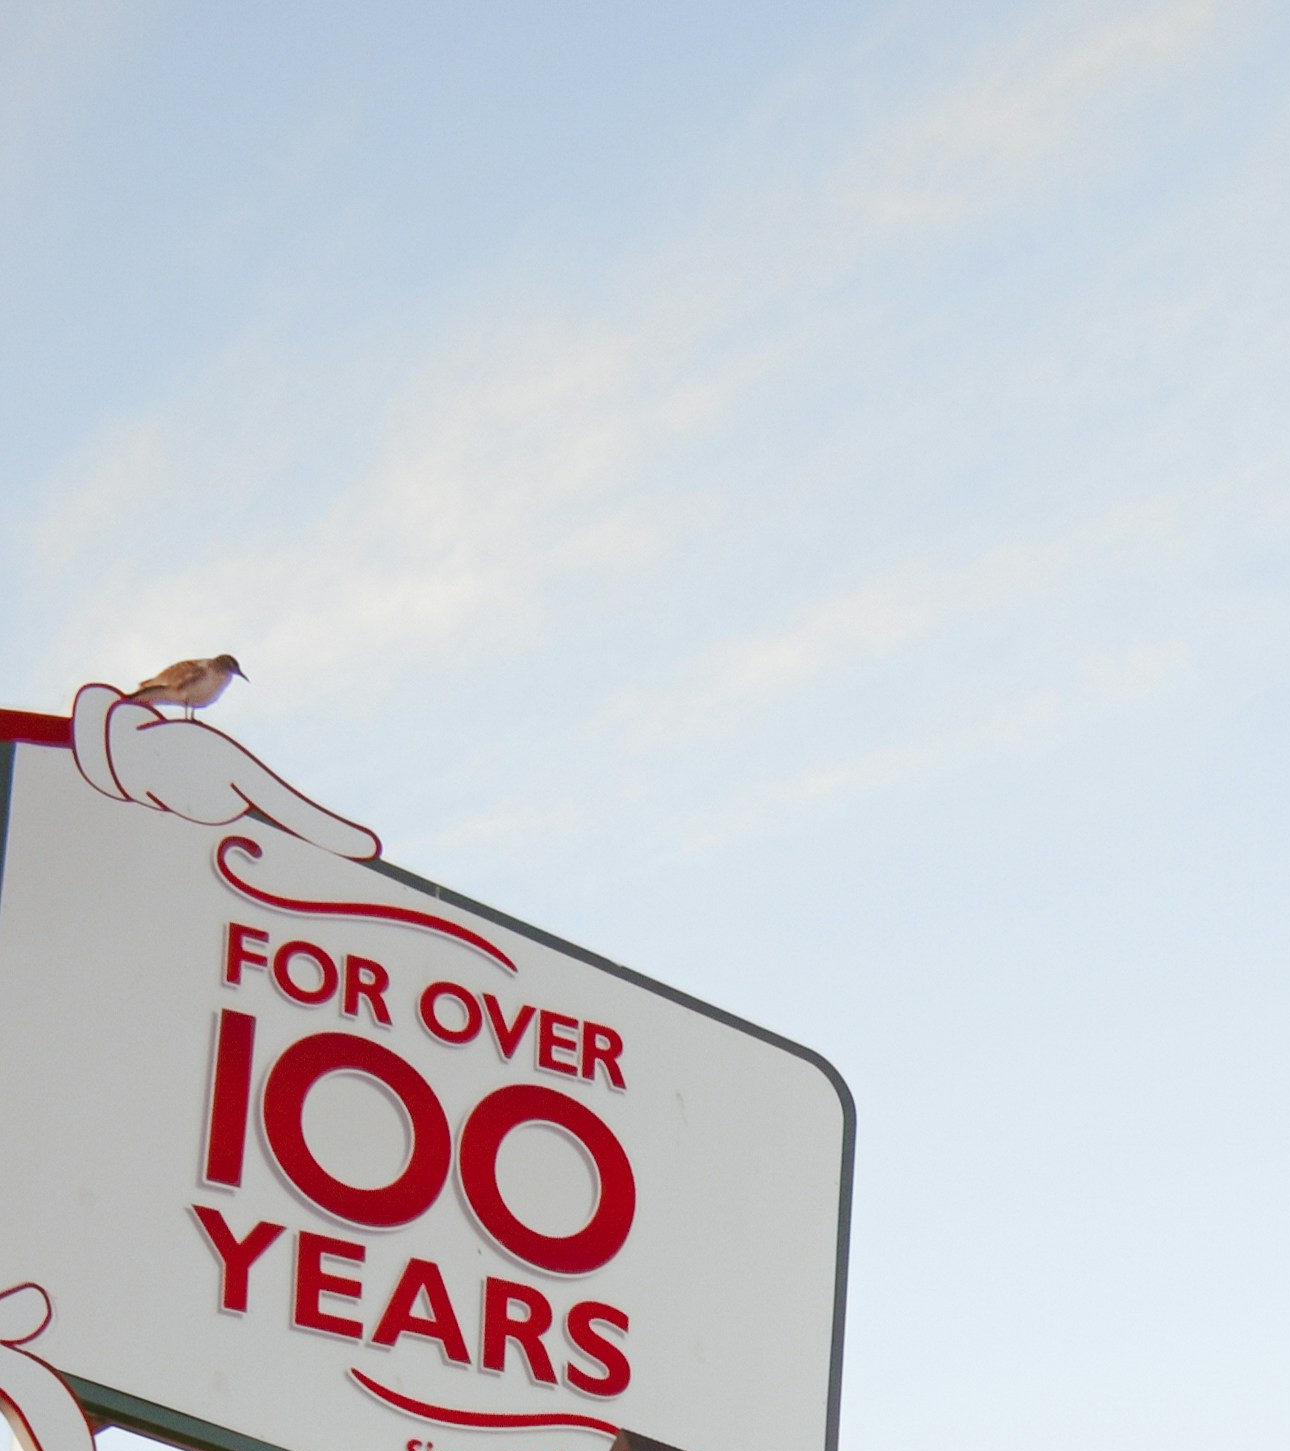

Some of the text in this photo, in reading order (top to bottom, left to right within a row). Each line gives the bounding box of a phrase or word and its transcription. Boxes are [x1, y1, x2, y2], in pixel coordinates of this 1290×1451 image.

[224, 921, 628, 1091] FOR OVER
[205, 1008, 637, 1275] 100
[191, 1203, 632, 1399] YEARS
